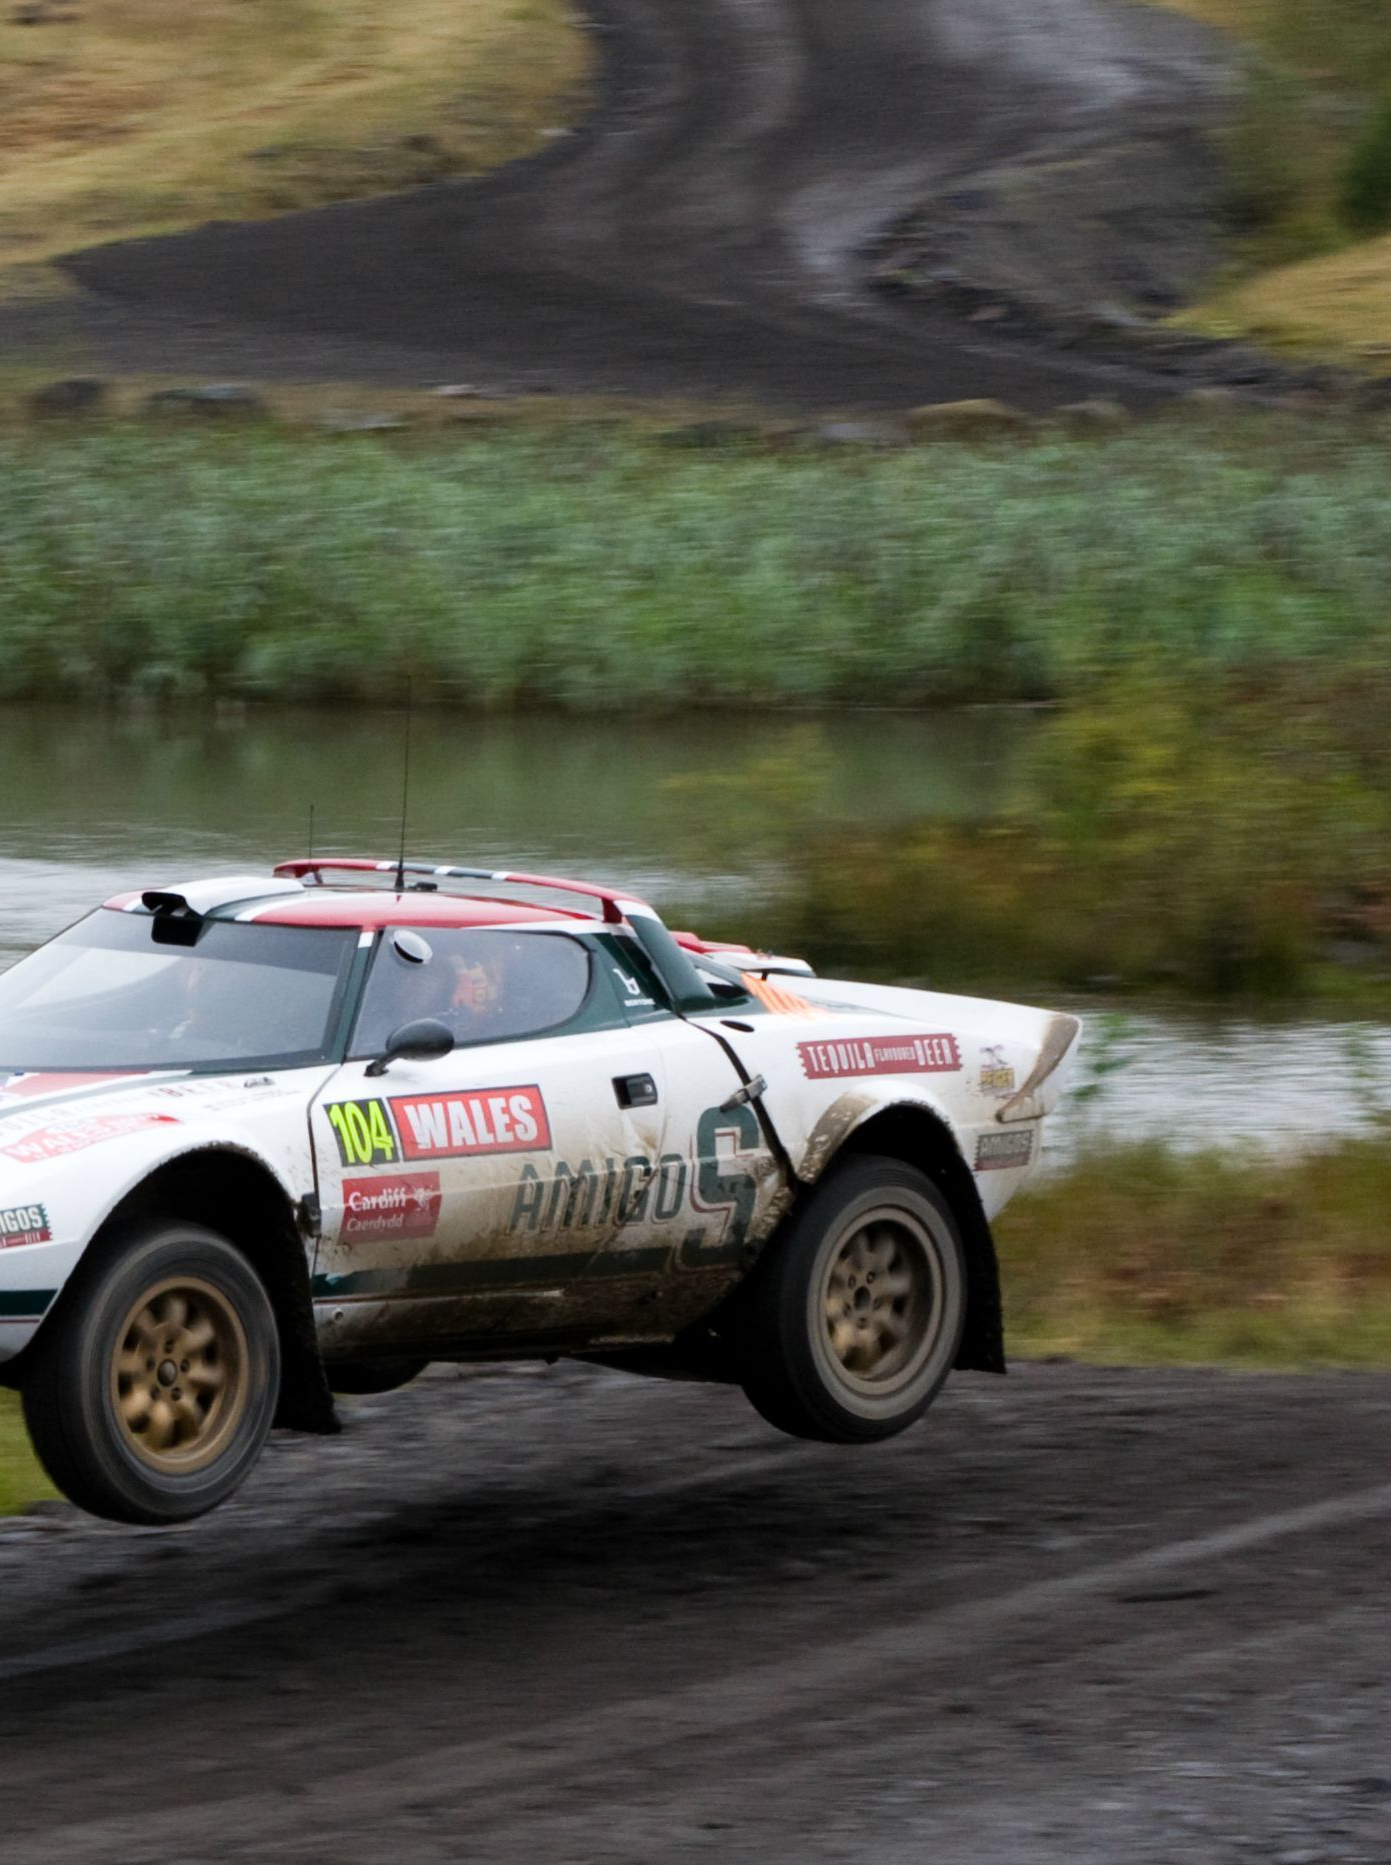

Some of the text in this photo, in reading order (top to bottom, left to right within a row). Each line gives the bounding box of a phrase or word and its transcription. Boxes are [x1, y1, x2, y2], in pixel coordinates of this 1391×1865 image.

[807, 1042, 875, 1073] TEQUILA
[914, 1039, 953, 1066] BEER
[329, 1095, 539, 1164] 104 WALES
[349, 1187, 408, 1211] Cardiff
[507, 1106, 760, 1269] AMIGOS
[346, 1214, 404, 1233] Caerdydd
